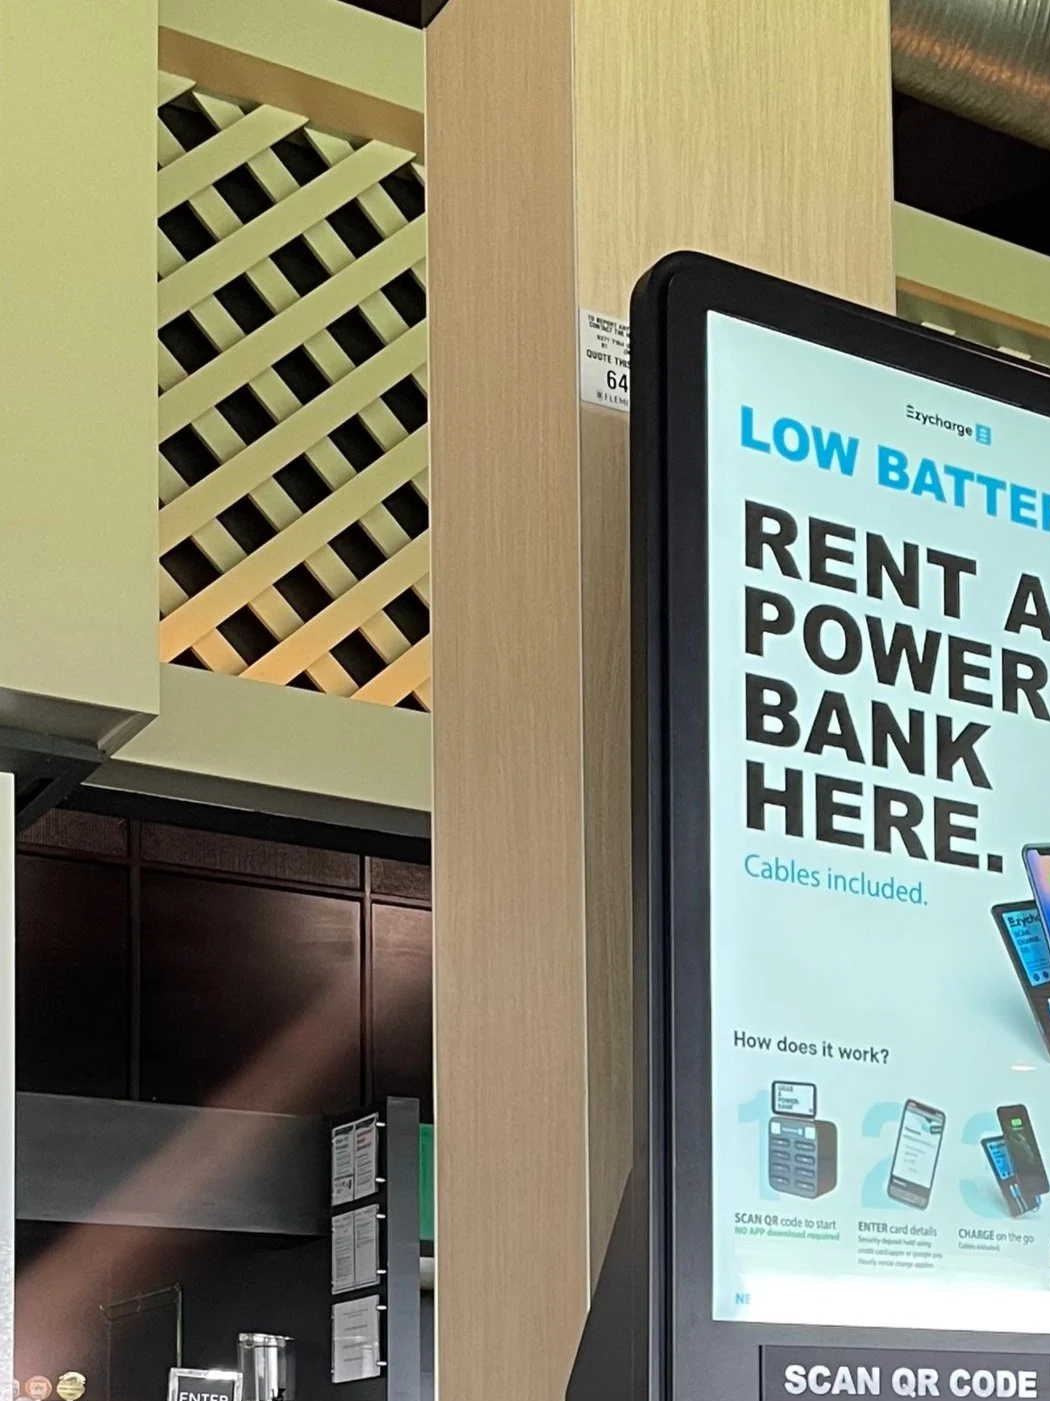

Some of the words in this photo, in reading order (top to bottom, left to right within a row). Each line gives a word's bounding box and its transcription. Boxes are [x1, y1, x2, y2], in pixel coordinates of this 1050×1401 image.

[586, 349, 612, 364] QUOTE
[606, 370, 628, 393] 64
[906, 404, 973, 437] Ezycharge
[740, 405, 860, 478] LOW
[744, 498, 977, 620] RENT
[744, 672, 994, 790] BANK
[745, 760, 1004, 874] HERE.
[744, 854, 820, 888] Cables
[828, 868, 928, 906] included.
[734, 1030, 772, 1050] How
[777, 1036, 818, 1055] does
[822, 1041, 834, 1058] it
[838, 1047, 889, 1064] work?
[735, 1212, 762, 1225] SCAN
[764, 1215, 779, 1227] QR
[781, 1217, 803, 1228] code
[805, 1218, 814, 1228] to
[816, 1220, 836, 1230] start
[858, 1221, 888, 1233] ENTER
[889, 1224, 908, 1235] card
[910, 1225, 938, 1237] details
[959, 1228, 994, 1241] CHARGE
[996, 1233, 1007, 1241] on
[1008, 1232, 1022, 1242] the
[1023, 1235, 1035, 1245] go
[784, 1364, 881, 1396] SCAN
[891, 1367, 939, 1399] QR
[949, 1369, 1038, 1399] CODE
